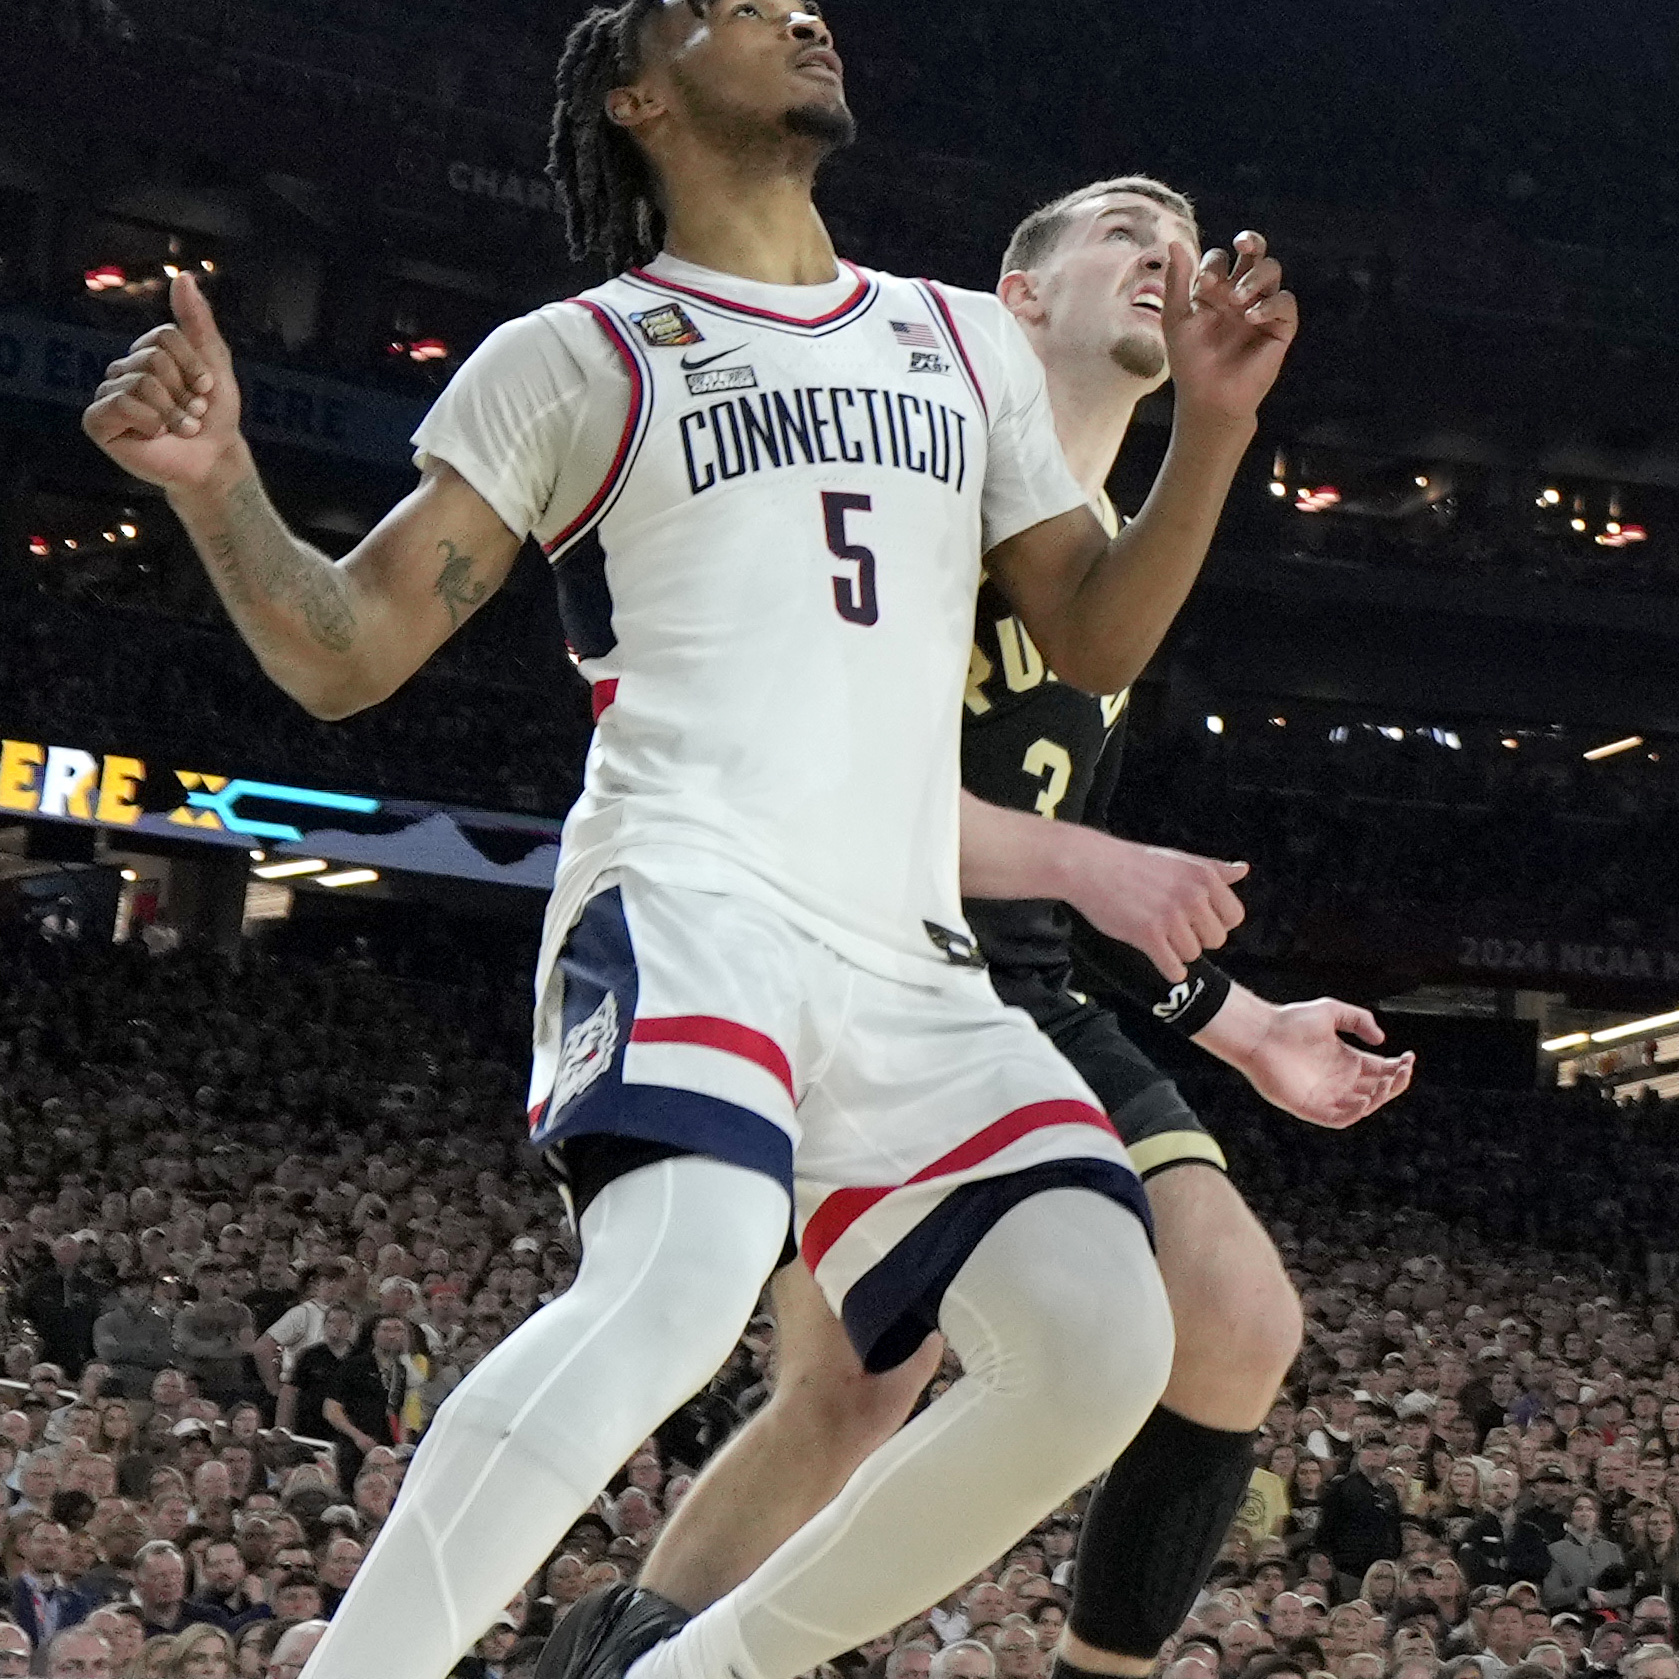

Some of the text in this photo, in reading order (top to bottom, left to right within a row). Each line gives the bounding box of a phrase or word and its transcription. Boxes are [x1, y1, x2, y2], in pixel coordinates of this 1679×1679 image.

[447, 161, 562, 213] CHAR
[252, 379, 348, 440] ERE
[678, 386, 967, 494] CONNECTICUT
[821, 492, 879, 627] 5
[0, 738, 148, 826] ERE
[1022, 736, 1073, 821] 3
[1457, 935, 1547, 971] 2024
[1558, 942, 1652, 980] NCAA
